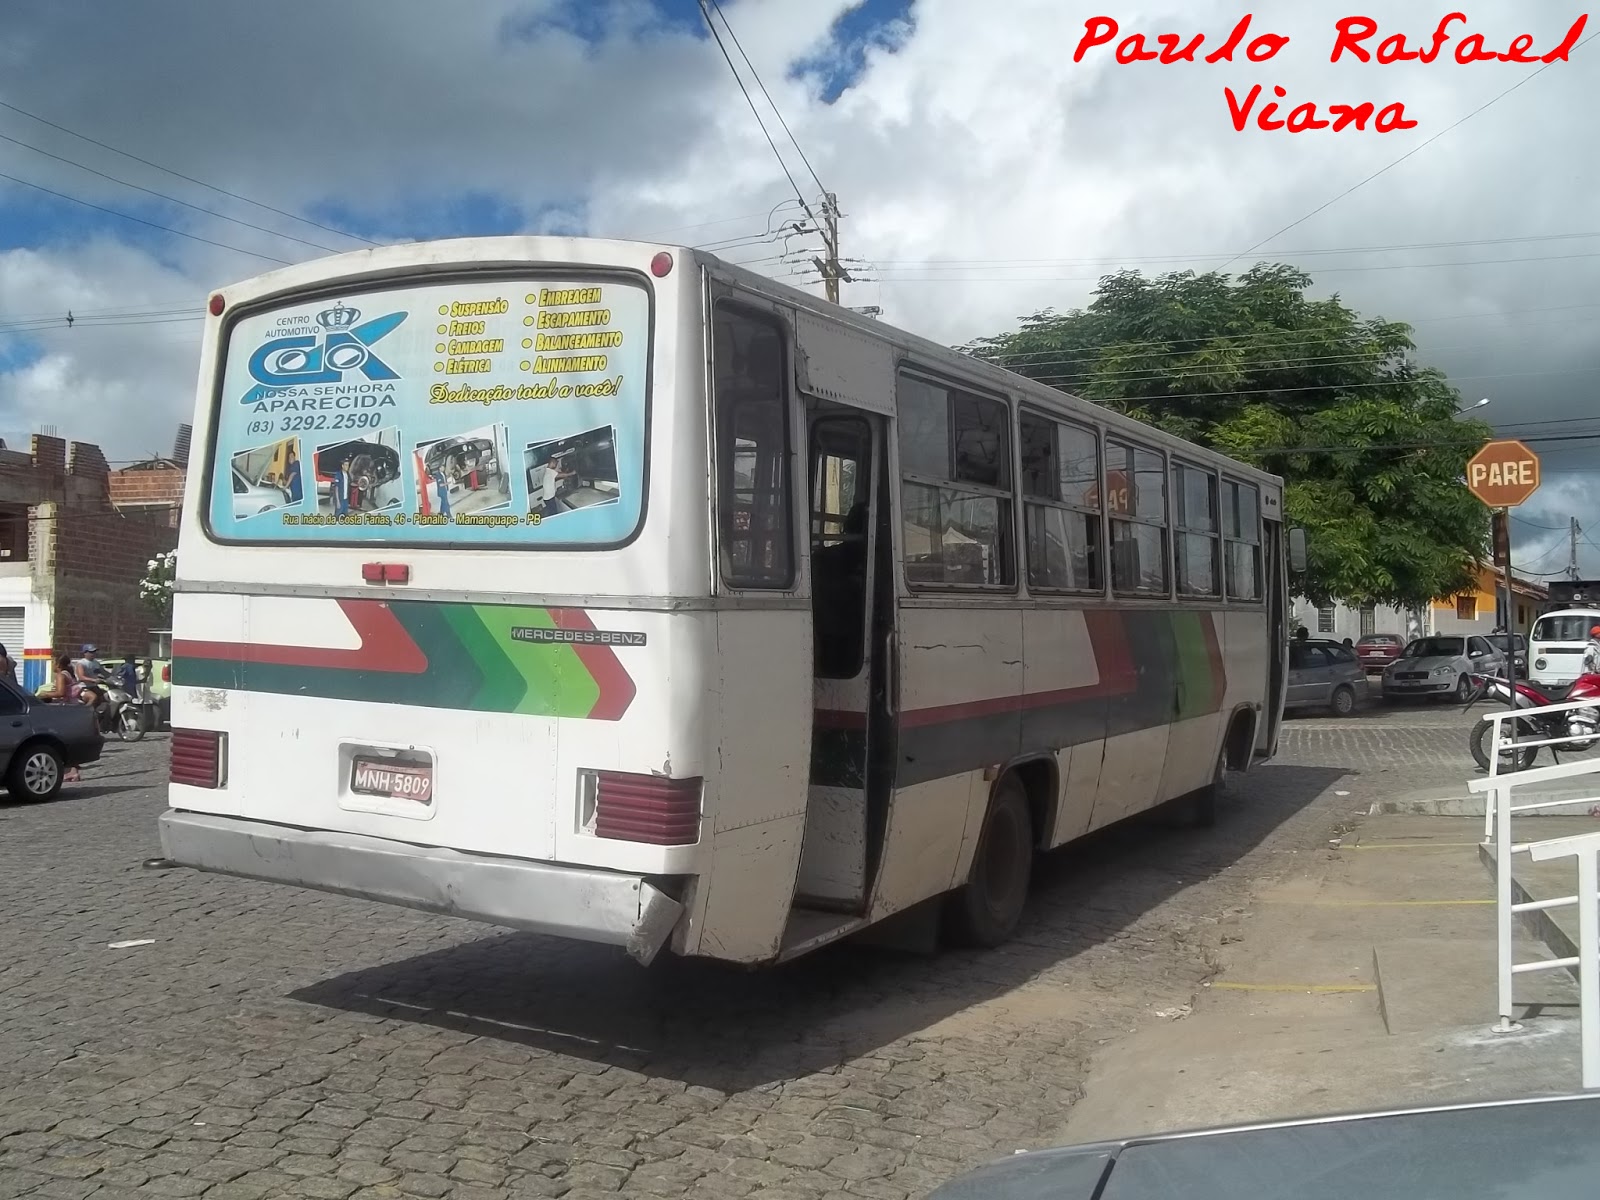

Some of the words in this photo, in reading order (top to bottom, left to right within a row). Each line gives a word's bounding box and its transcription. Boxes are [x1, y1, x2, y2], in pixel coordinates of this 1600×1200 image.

[276, 315, 310, 326] CENTRO
[448, 320, 486, 337] FREIOS
[265, 325, 320, 338] AUTOMOTIVO
[255, 387, 309, 400] NOSSA
[313, 383, 396, 397] SENHORA
[429, 381, 516, 406] Dedicação
[516, 376, 560, 401] total
[558, 386, 573, 399] a
[575, 374, 624, 399] você!
[253, 394, 397, 414] APARECIDA
[247, 420, 275, 436] (83)
[280, 411, 382, 433] 3292.2590
[1472, 460, 1534, 488] PARE
[283, 512, 300, 526] Rua
[325, 512, 337, 526] da
[338, 513, 363, 526] Costa
[394, 512, 407, 526] 46
[455, 512, 519, 529] Mamanguape
[526, 512, 542, 526] PB
[513, 628, 645, 645] MERCEDES-BENZ
